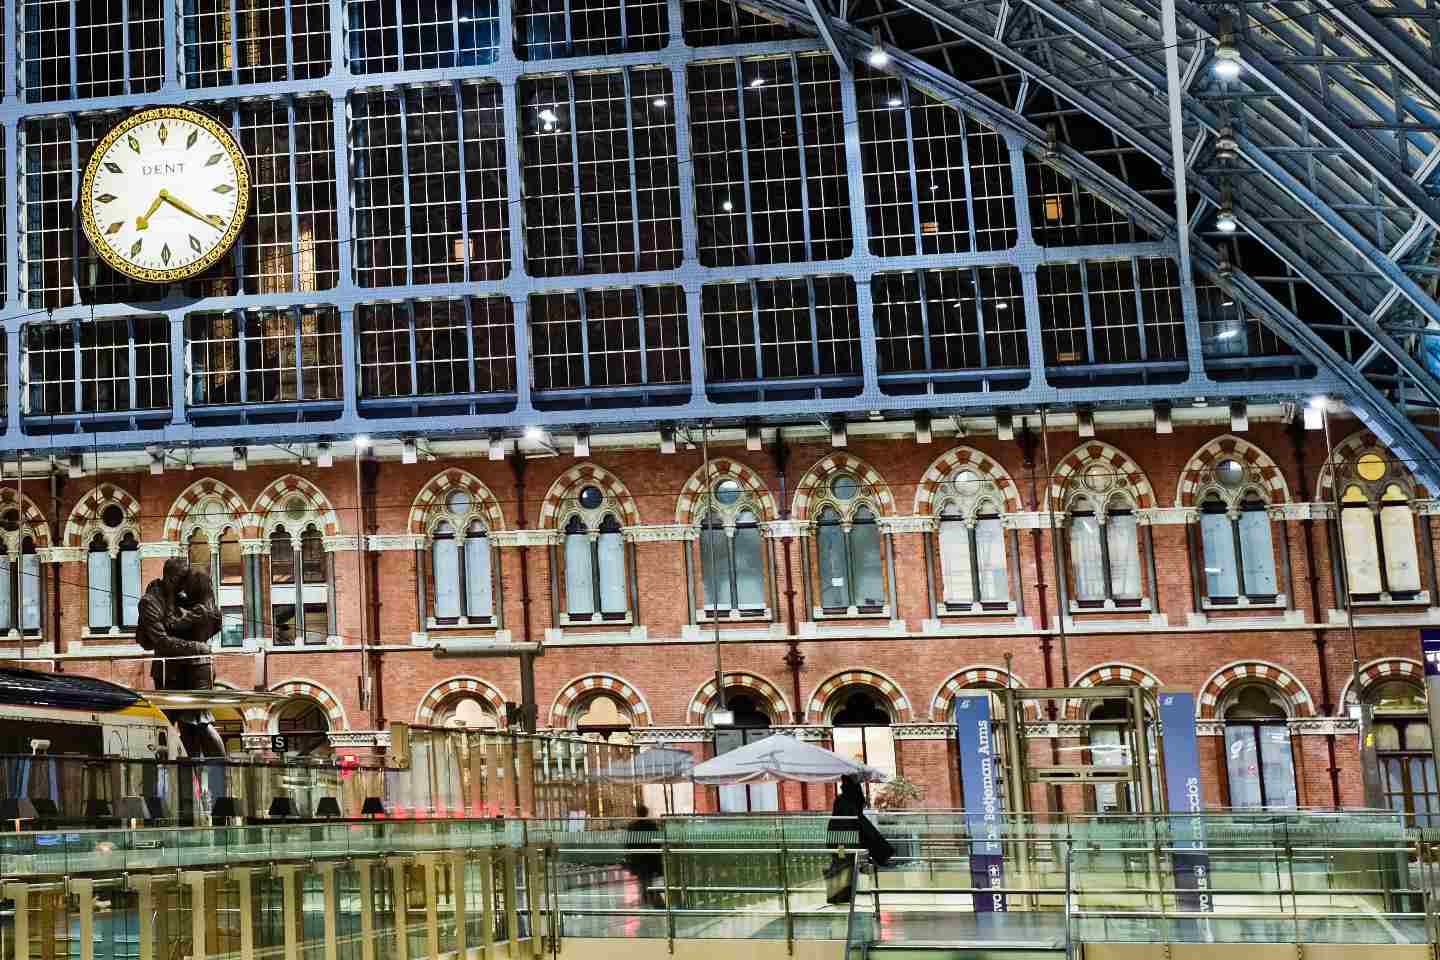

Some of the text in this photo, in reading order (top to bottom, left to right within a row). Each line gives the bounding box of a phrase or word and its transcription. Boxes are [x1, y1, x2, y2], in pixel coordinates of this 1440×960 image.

[142, 162, 184, 176] DENT
[275, 736, 284, 748] S
[977, 720, 990, 756] Arms
